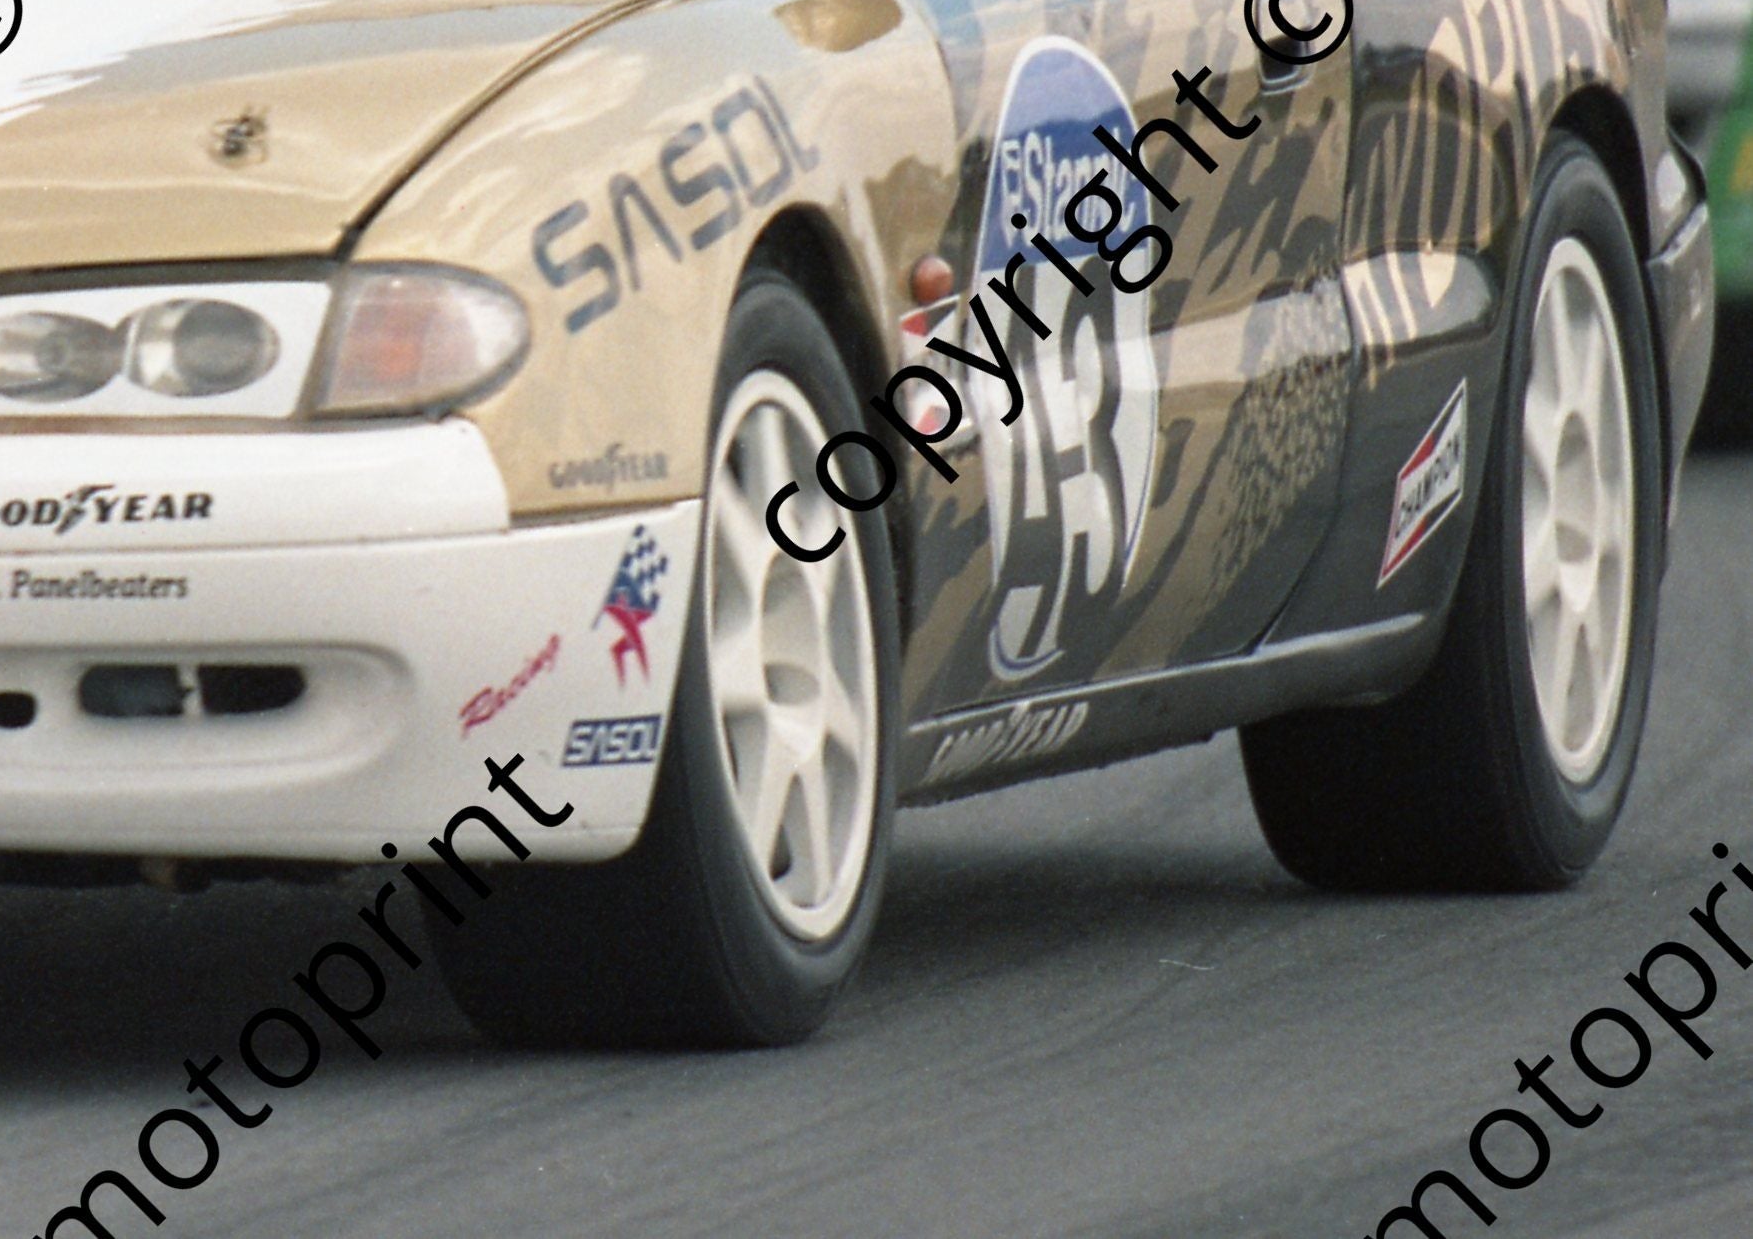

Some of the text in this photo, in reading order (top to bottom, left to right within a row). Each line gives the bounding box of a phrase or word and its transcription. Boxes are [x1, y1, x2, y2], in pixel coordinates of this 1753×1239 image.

[531, 76, 821, 333] SASOL
[10, 568, 189, 600] Panelbeaters
[565, 720, 658, 763] SASOL
